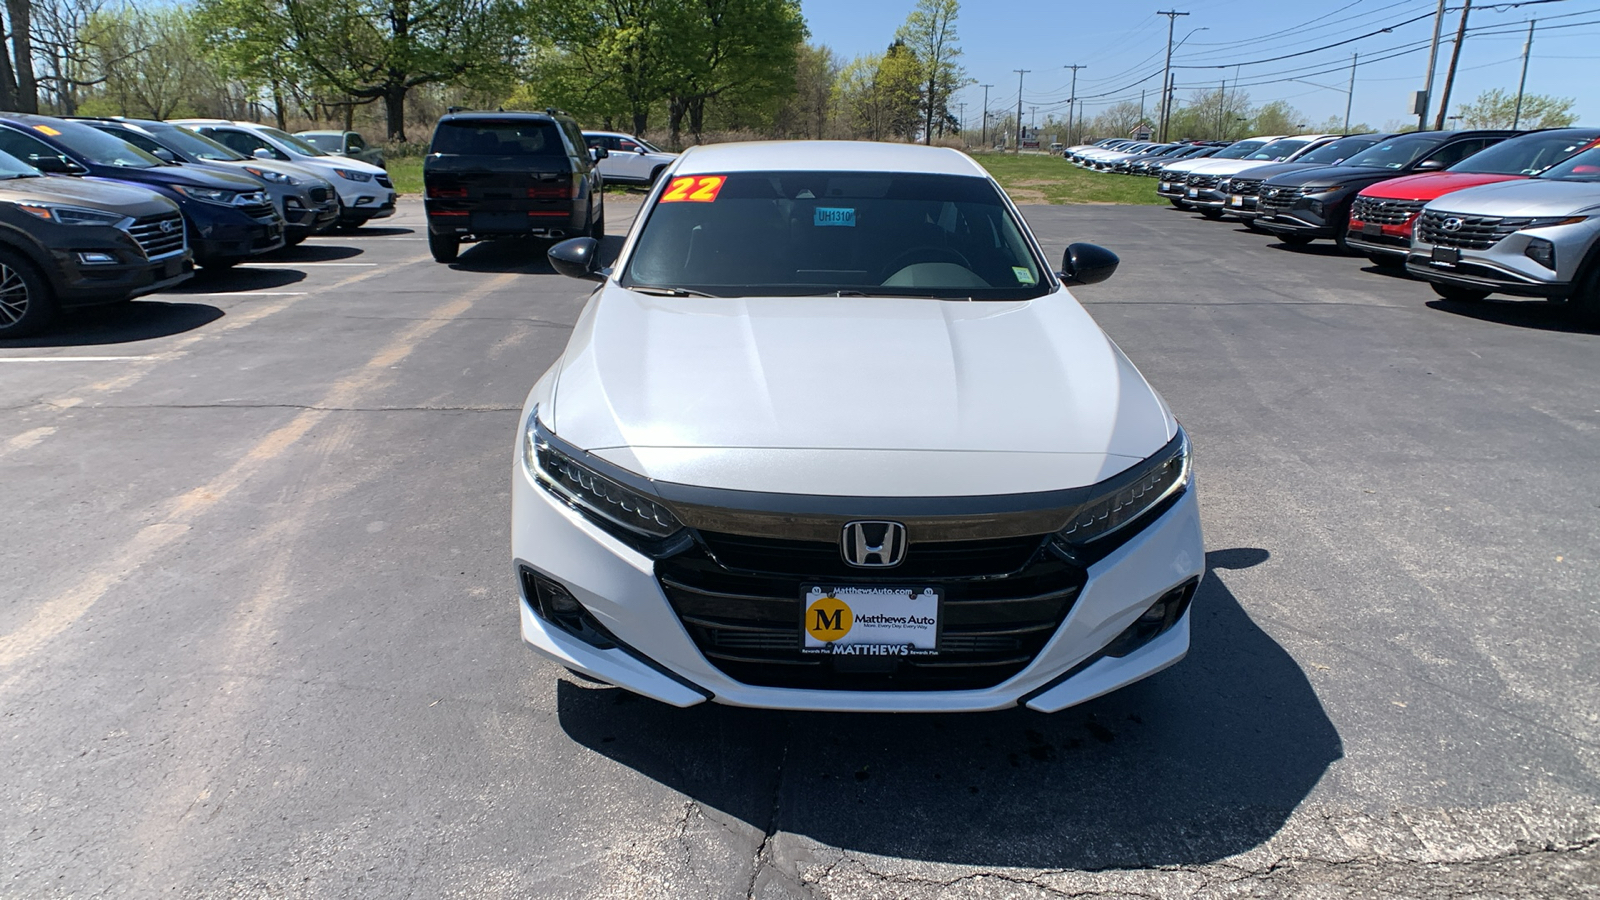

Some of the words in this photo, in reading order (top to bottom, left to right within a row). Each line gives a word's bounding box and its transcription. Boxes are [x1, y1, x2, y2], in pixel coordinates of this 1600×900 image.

[663, 177, 721, 200] 22
[833, 587, 913, 596] MatthewsAuto.com
[813, 609, 845, 631] M
[855, 613, 906, 624] Matthews
[908, 615, 935, 625] Auto
[832, 644, 909, 656] MATTHEWS
